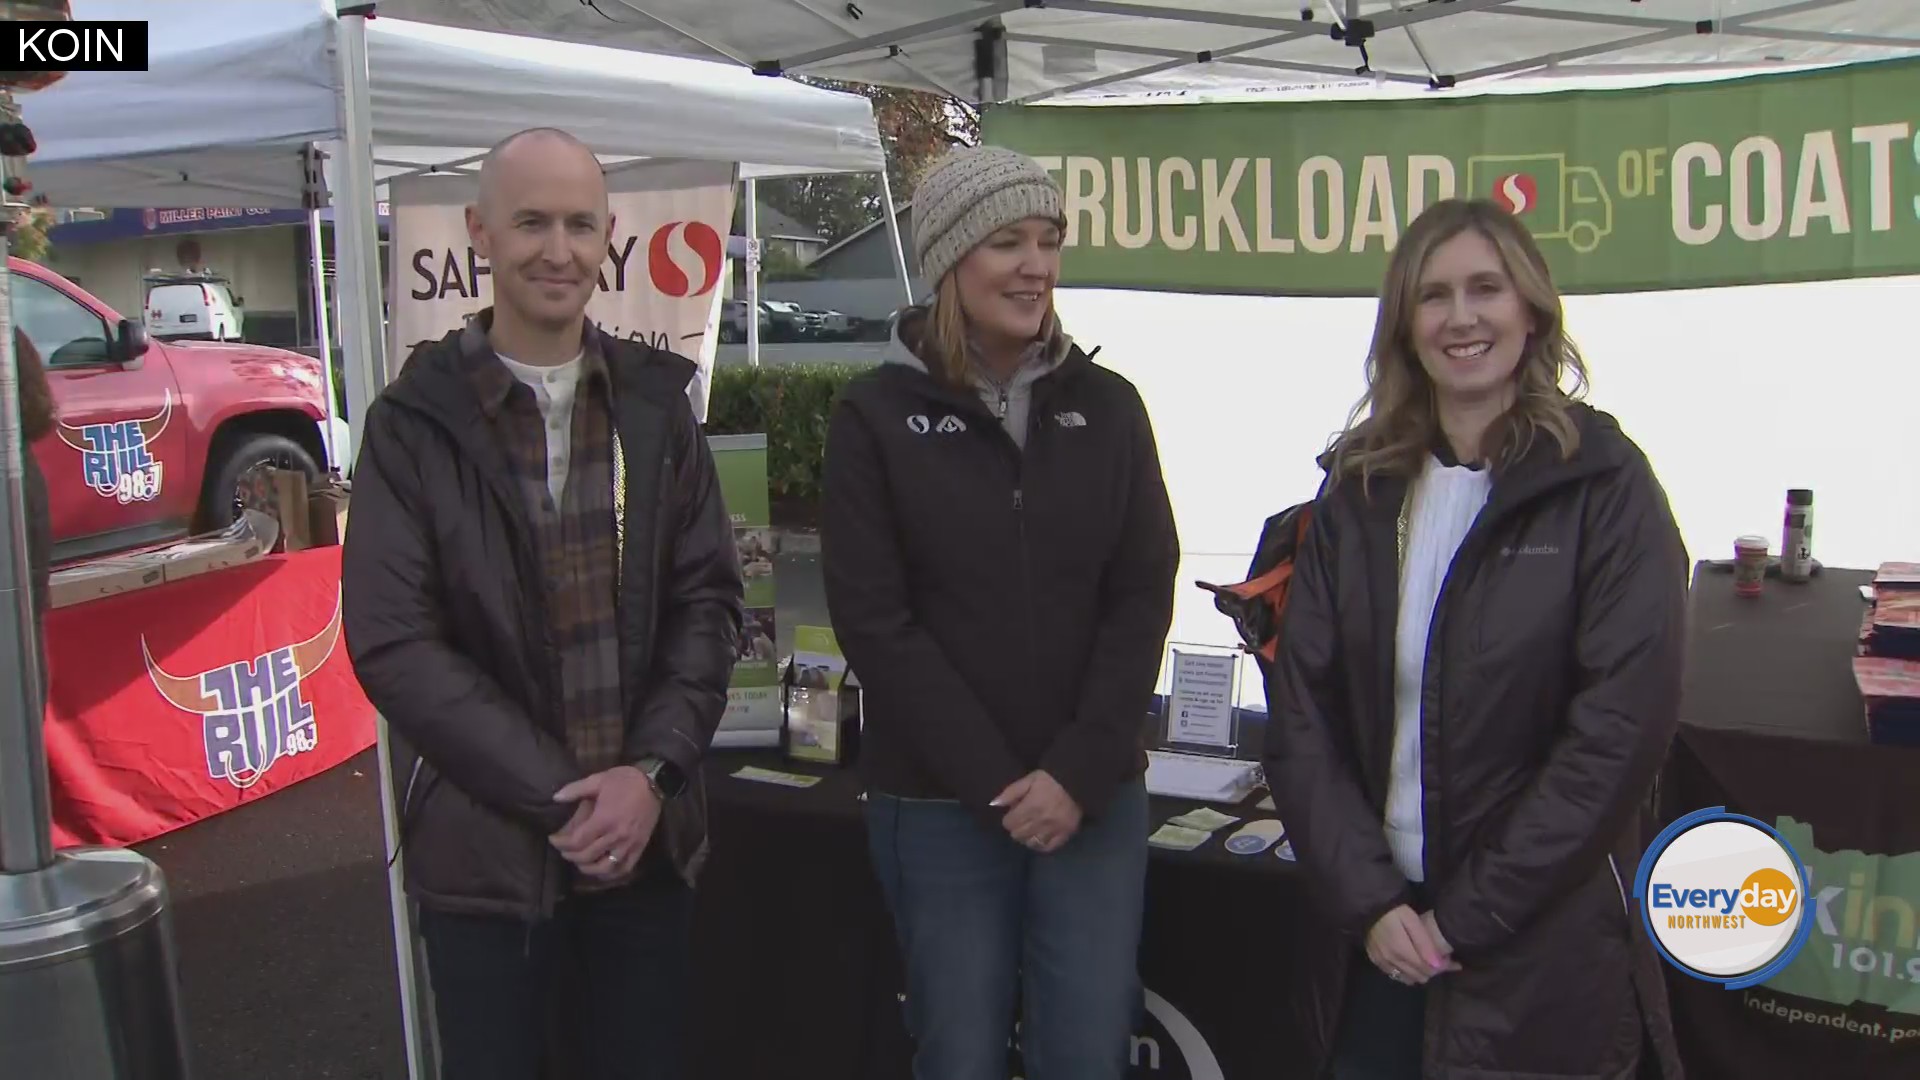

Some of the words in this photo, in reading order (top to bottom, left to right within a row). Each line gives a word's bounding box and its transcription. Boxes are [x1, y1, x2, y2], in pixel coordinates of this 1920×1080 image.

[1040, 154, 1456, 254] RUCKLOAD
[1617, 147, 1668, 198] OF
[1671, 121, 1920, 245] COAT
[159, 207, 204, 224] MILLER
[206, 207, 243, 220] PAINT
[411, 235, 638, 301] SAFY
[83, 420, 145, 453] THE
[118, 461, 163, 504] 98.7
[200, 645, 301, 711] THE
[285, 722, 318, 757] 98.7
[1803, 864, 1920, 950] kin
